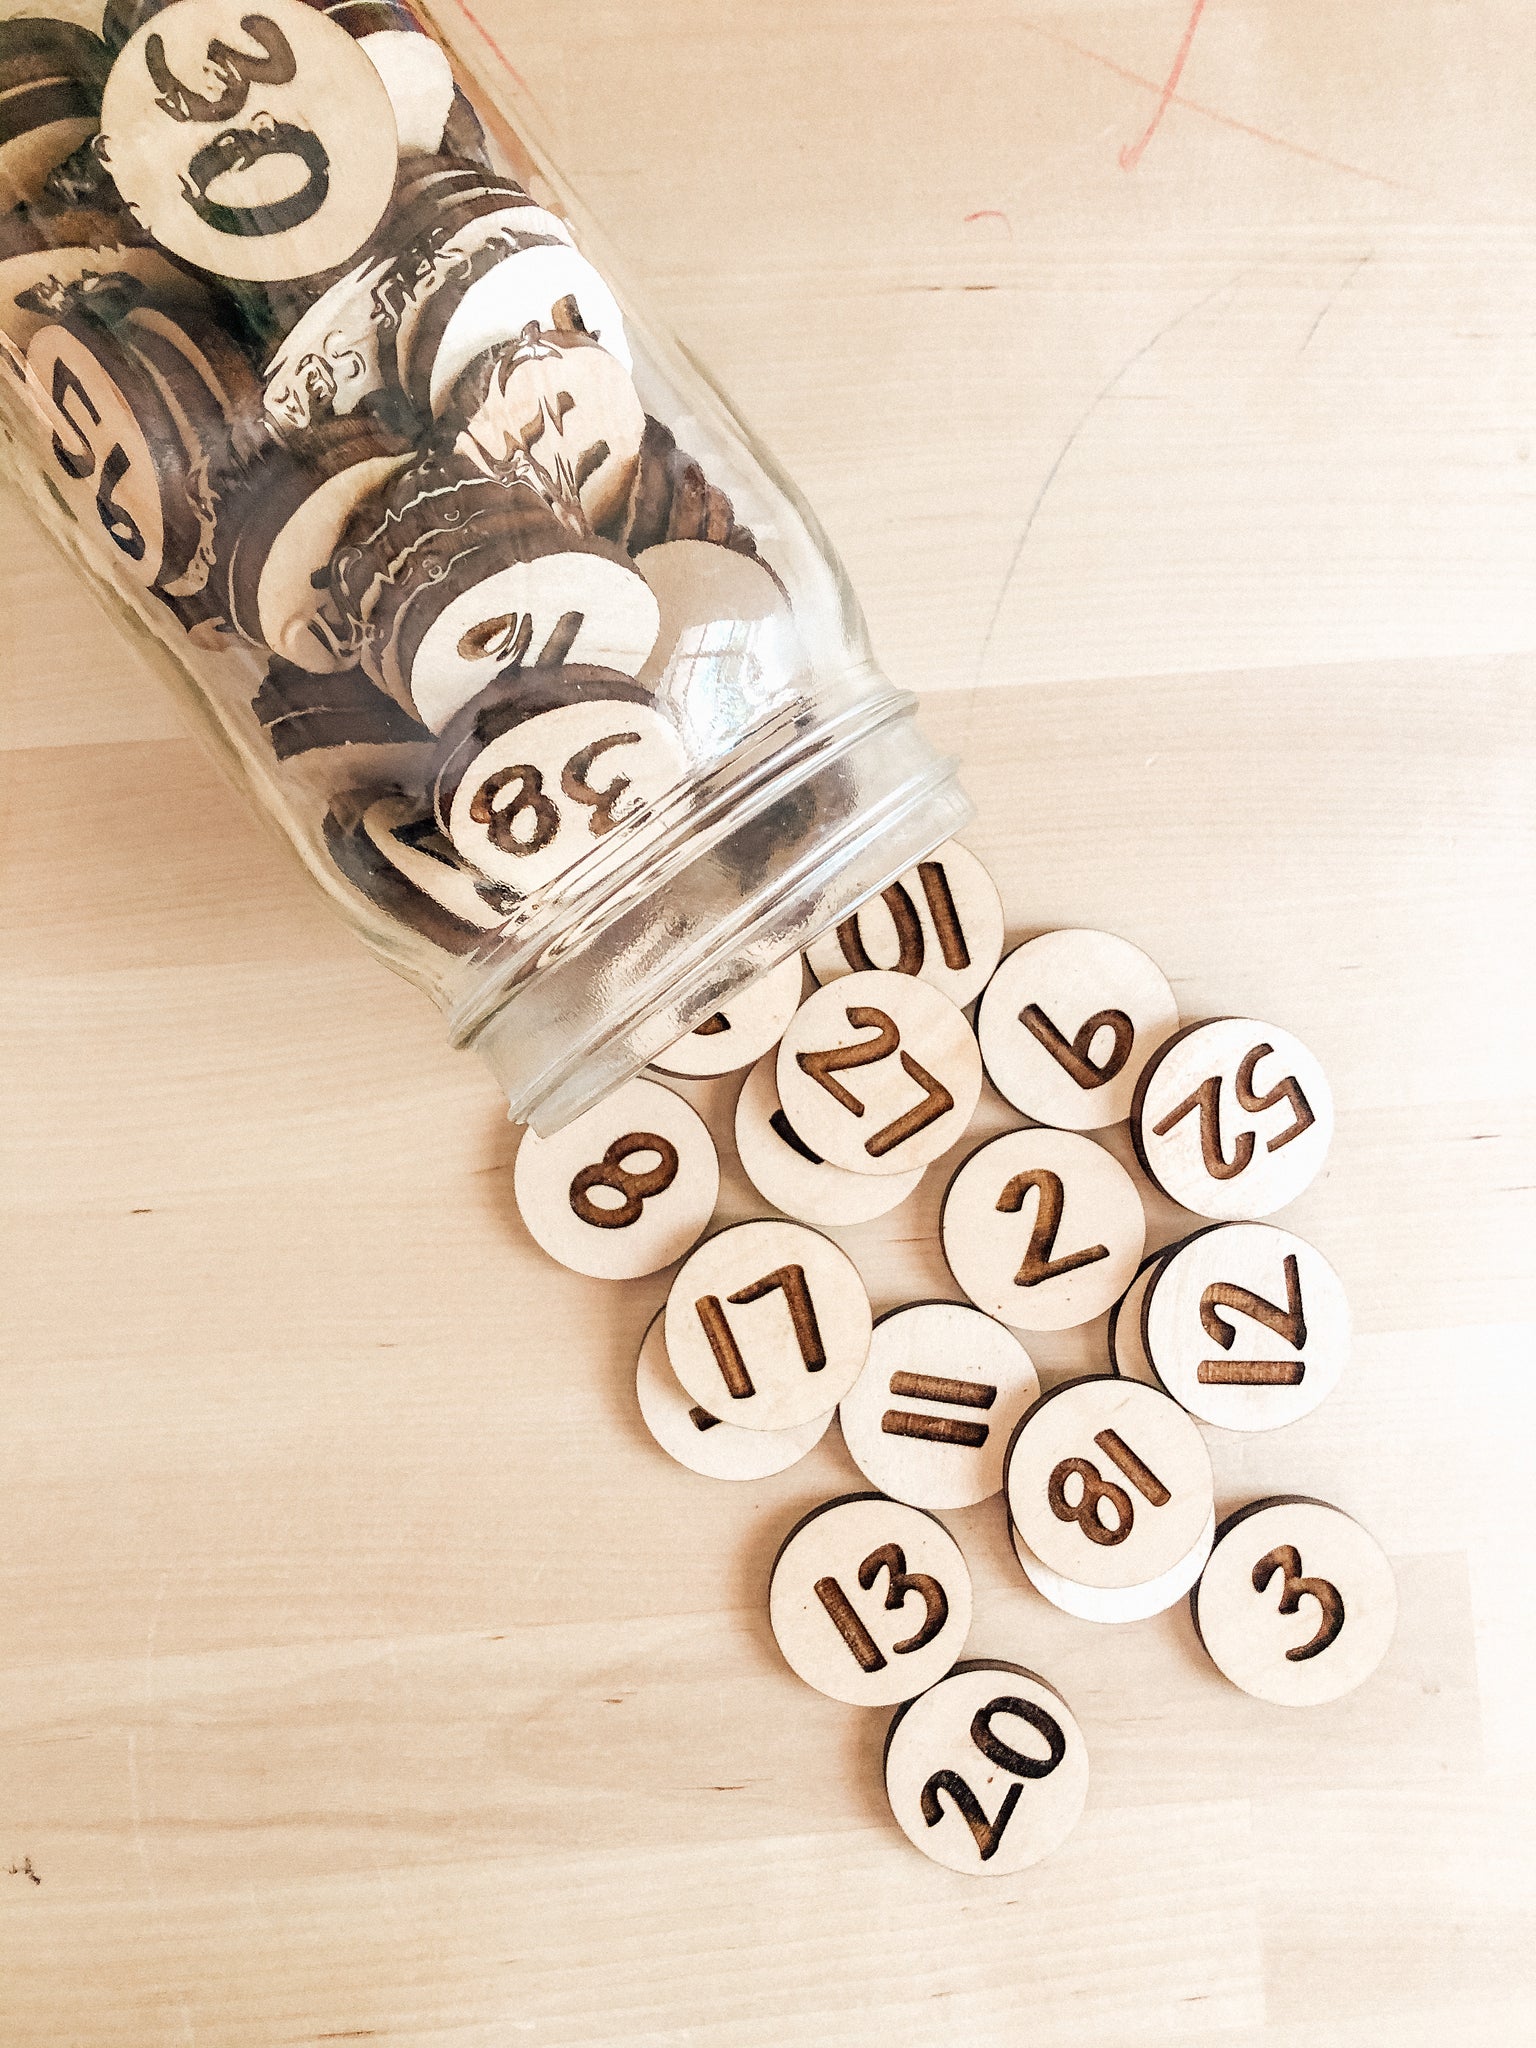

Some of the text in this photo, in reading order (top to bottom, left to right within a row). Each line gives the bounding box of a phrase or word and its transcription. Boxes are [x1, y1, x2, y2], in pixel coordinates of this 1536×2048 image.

[145, 14, 330, 237] 30
[796, 1006, 955, 1158] 27
[1152, 1042, 1316, 1180] 52
[569, 1131, 679, 1229] 8
[996, 1168, 1110, 1287] 2
[695, 1263, 827, 1399] 17
[1197, 1254, 1308, 1386] 12
[881, 1370, 998, 1448] 11
[1048, 1428, 1173, 1546] 18
[813, 1542, 949, 1674] 13
[1252, 1544, 1345, 1662] 3
[920, 1695, 1067, 1861] 20
